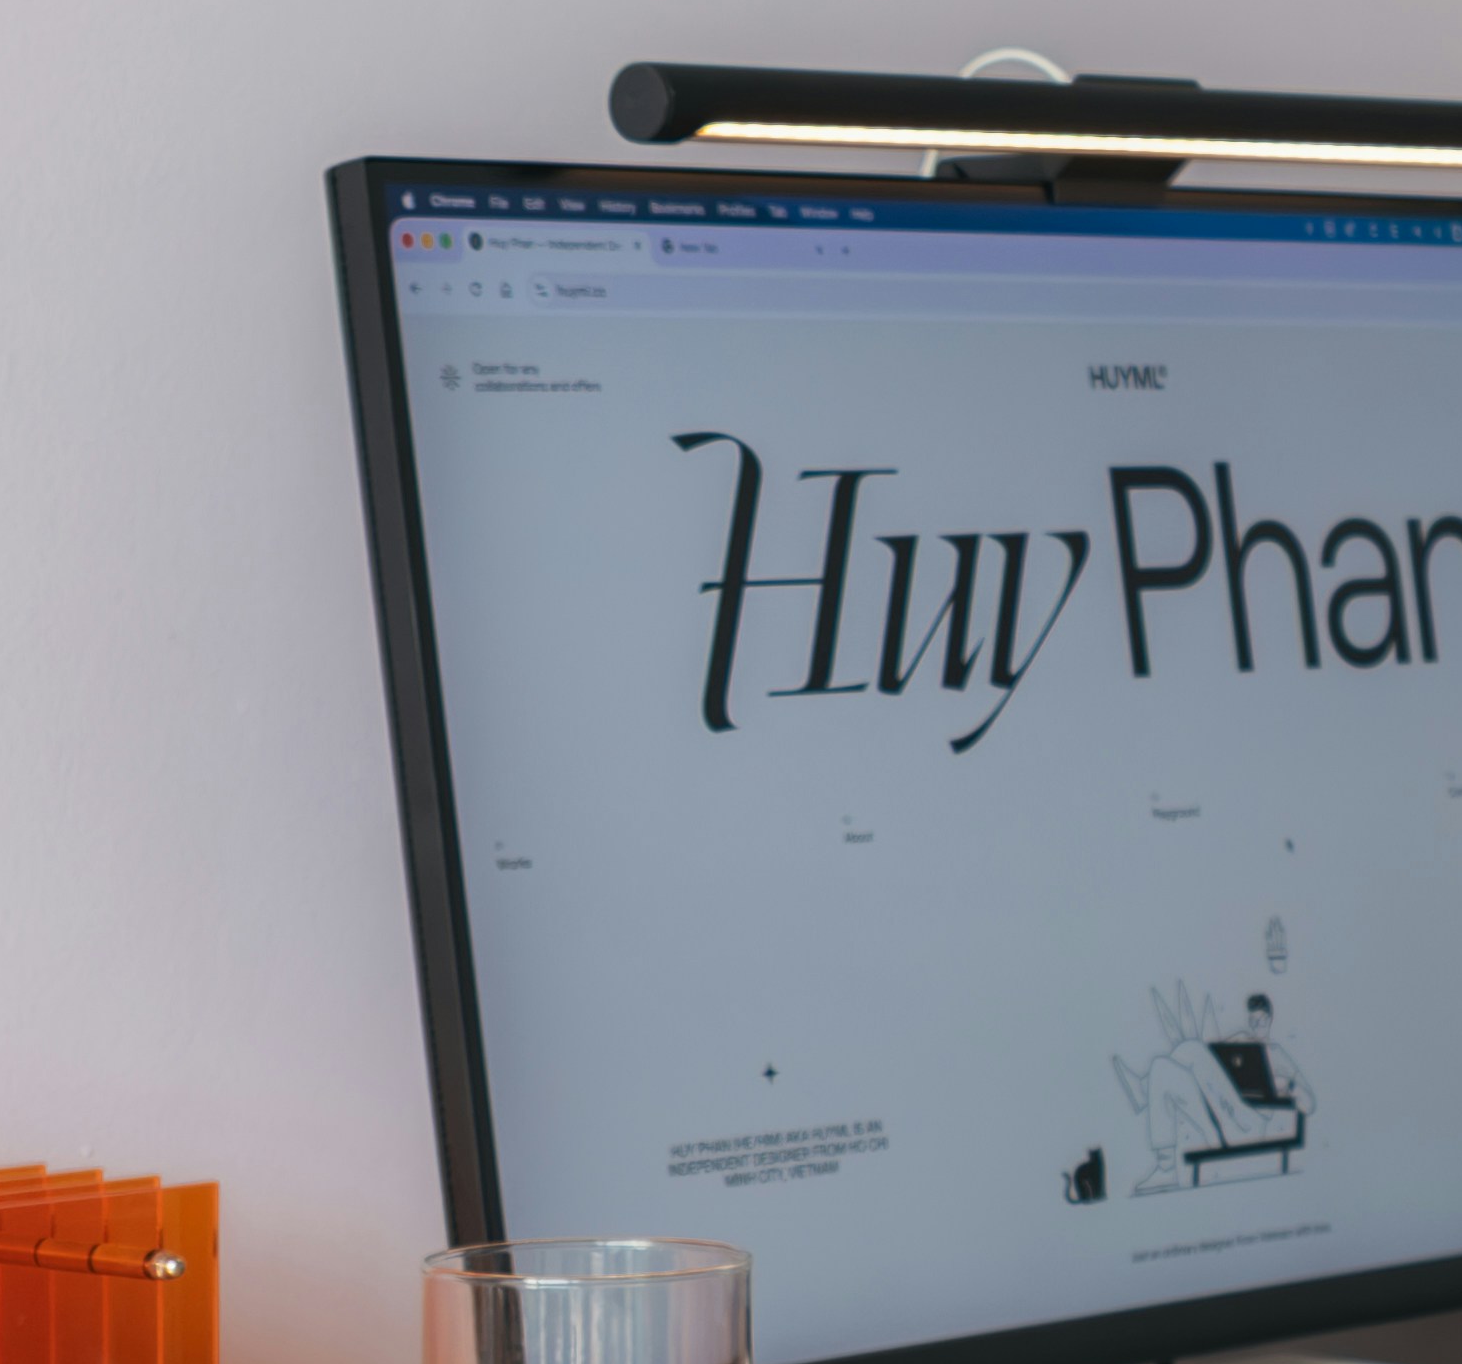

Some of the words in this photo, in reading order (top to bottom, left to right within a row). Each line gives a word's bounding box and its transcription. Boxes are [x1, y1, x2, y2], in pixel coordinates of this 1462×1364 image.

[430, 193, 476, 209] Chrome
[489, 196, 510, 210] File
[558, 198, 585, 212] View
[598, 200, 636, 216] History
[670, 431, 1091, 755] Huy
